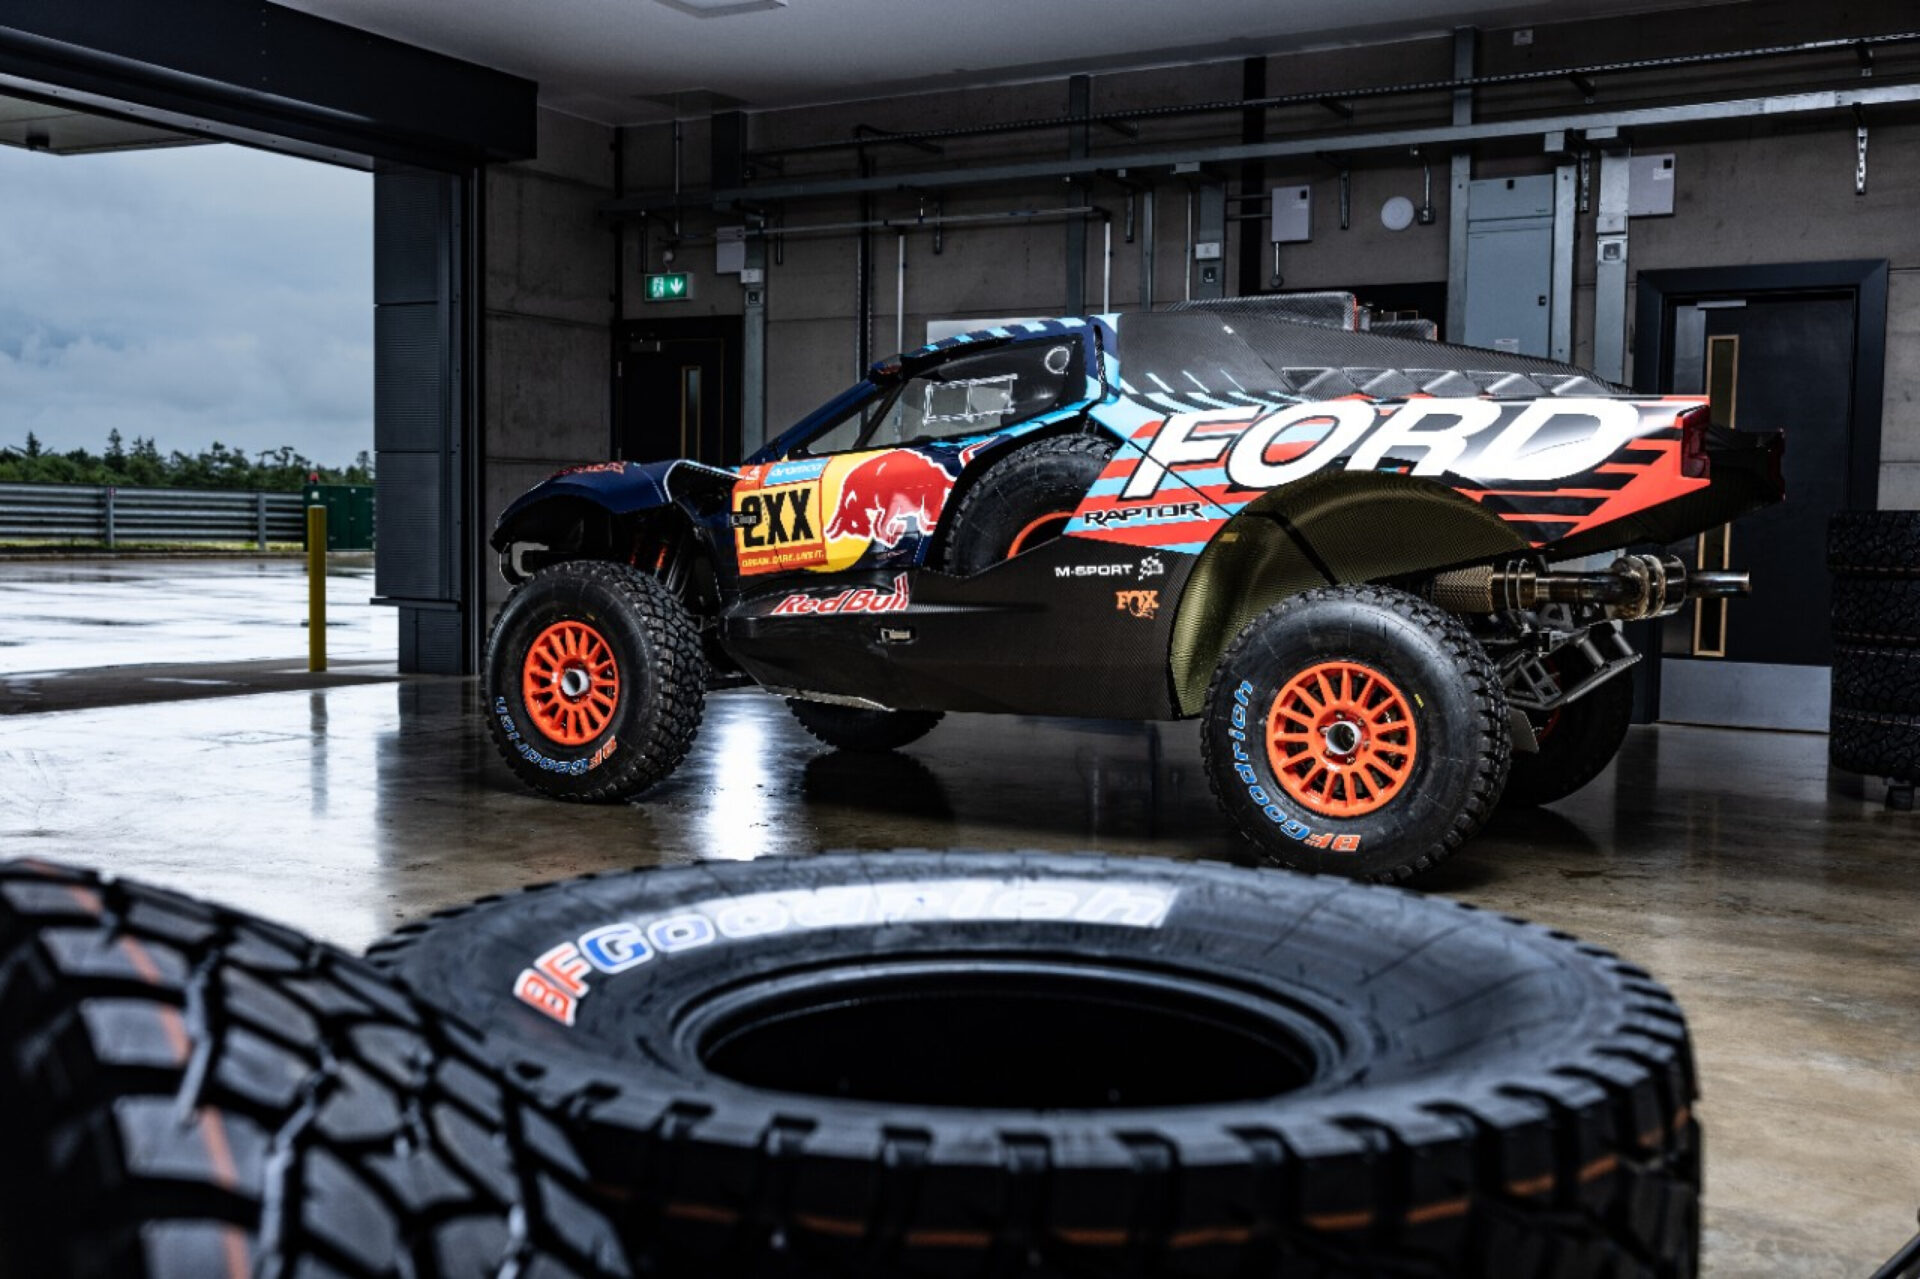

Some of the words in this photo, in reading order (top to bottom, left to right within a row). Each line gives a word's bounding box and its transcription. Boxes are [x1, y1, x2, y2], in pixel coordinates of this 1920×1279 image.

[1120, 398, 1639, 499] FORD
[741, 488, 814, 547] 2XX
[1083, 502, 1208, 530] RAPTOR
[770, 589, 855, 615] Red
[840, 571, 909, 613] Bull
[1055, 564, 1133, 577] M-SPORT
[1116, 590, 1160, 619] FOX
[1228, 680, 1361, 852] BFGoodrich
[513, 879, 1180, 1026] BFGoodrich
